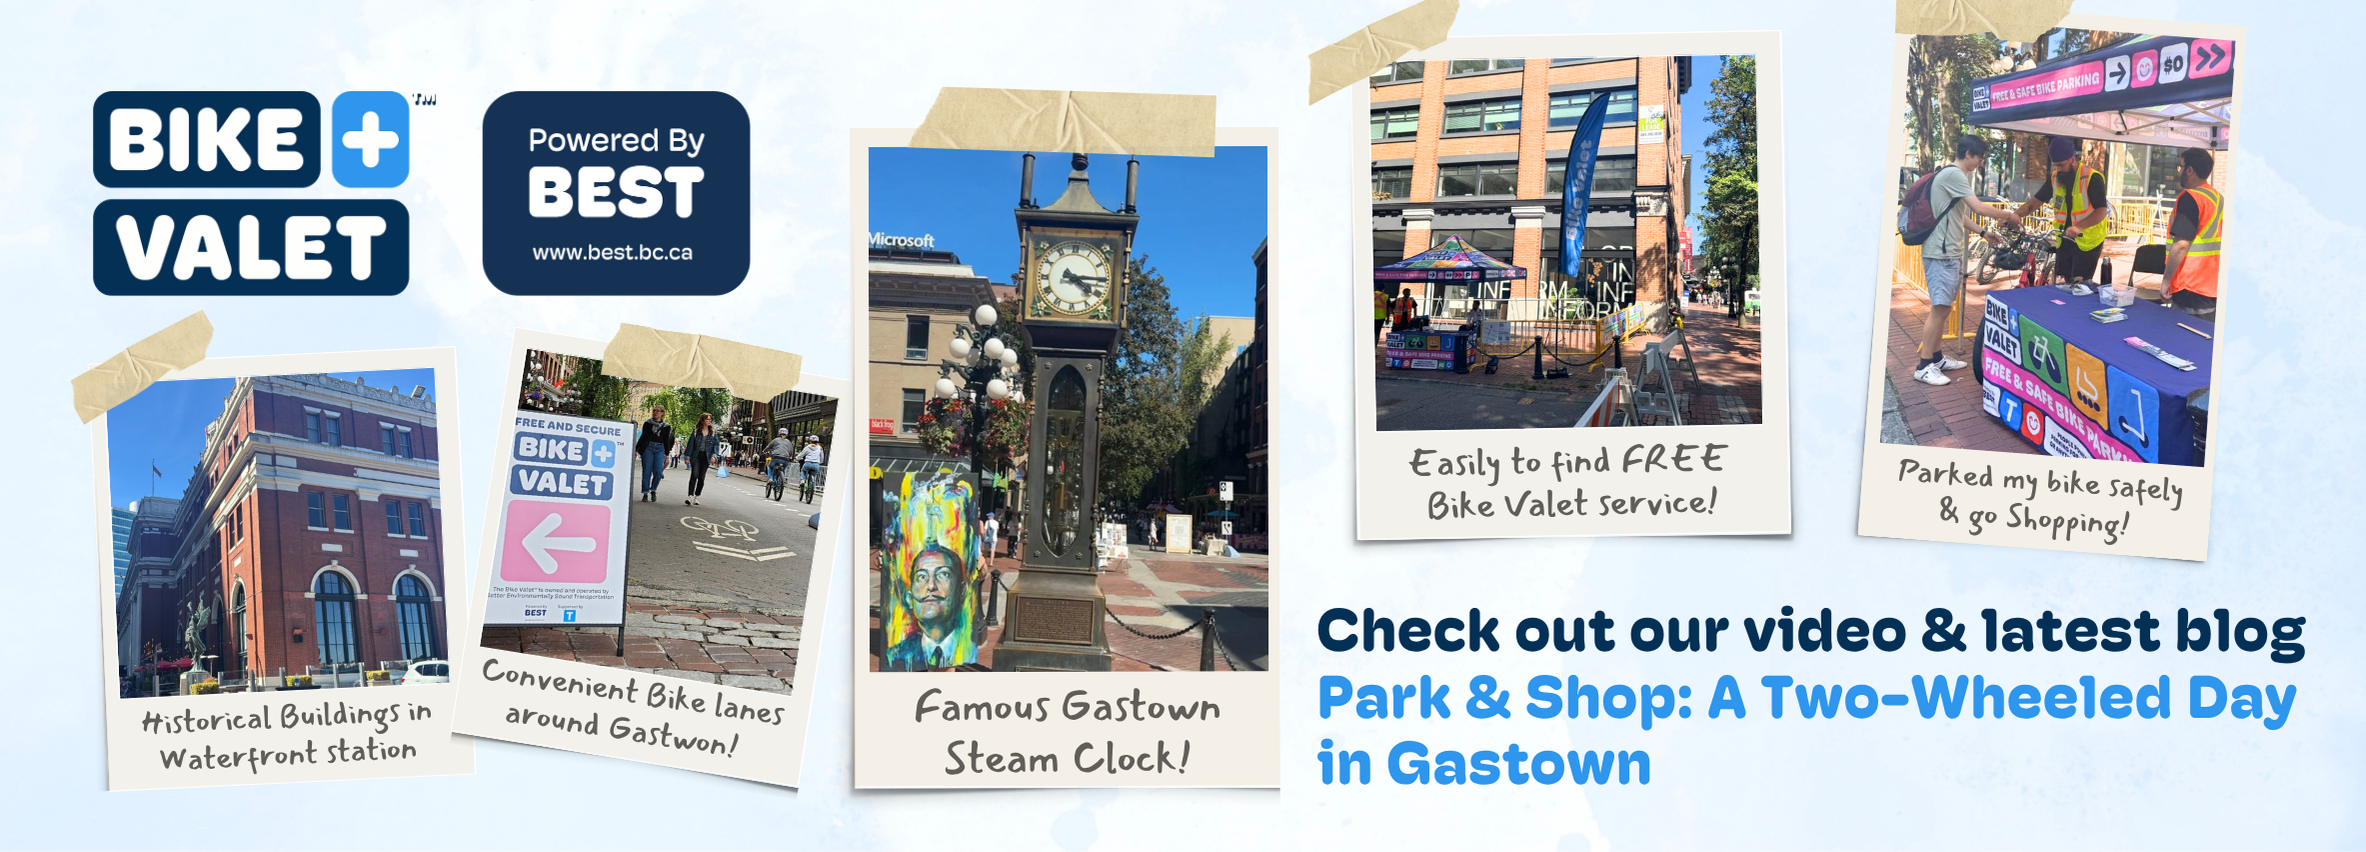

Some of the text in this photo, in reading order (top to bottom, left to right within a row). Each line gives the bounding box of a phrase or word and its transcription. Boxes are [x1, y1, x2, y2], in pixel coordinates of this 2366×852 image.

[2164, 55, 2183, 75] $0
[1992, 72, 2100, 102] FREE & SAFE BIKE PARKING
[1565, 140, 1592, 241] Bike Valet
[868, 231, 935, 248] Microsoft
[1987, 298, 2008, 326] BIKE
[1986, 324, 2018, 359] VALET
[1985, 357, 2011, 384] FREE
[2014, 373, 2024, 391] &
[2025, 380, 2054, 411] SAFE
[2055, 401, 2085, 436] BIKE
[2006, 397, 2018, 422] T
[515, 417, 621, 437] FREE AND SECURE
[519, 436, 584, 461] BIKE
[518, 469, 608, 496] VALET
[566, 611, 574, 621] T
